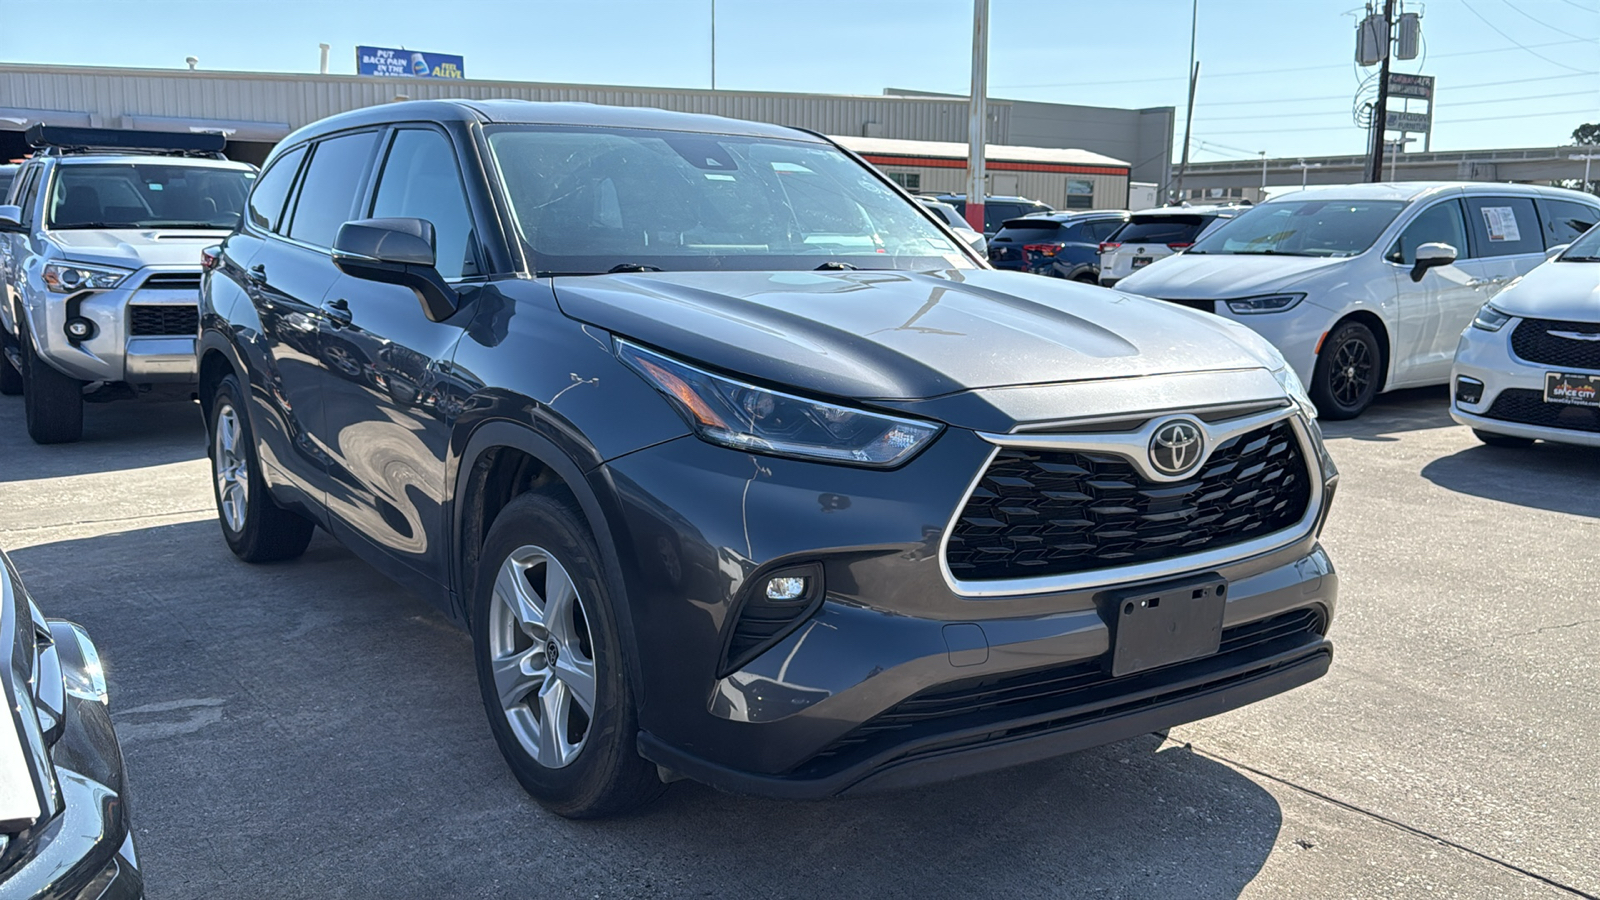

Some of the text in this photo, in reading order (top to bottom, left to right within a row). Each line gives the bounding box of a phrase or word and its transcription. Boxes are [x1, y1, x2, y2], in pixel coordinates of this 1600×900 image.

[377, 50, 394, 58] PUT
[363, 55, 407, 66] BACK PAIN
[377, 64, 404, 73] IN THE
[1553, 388, 1577, 396] SPACE
